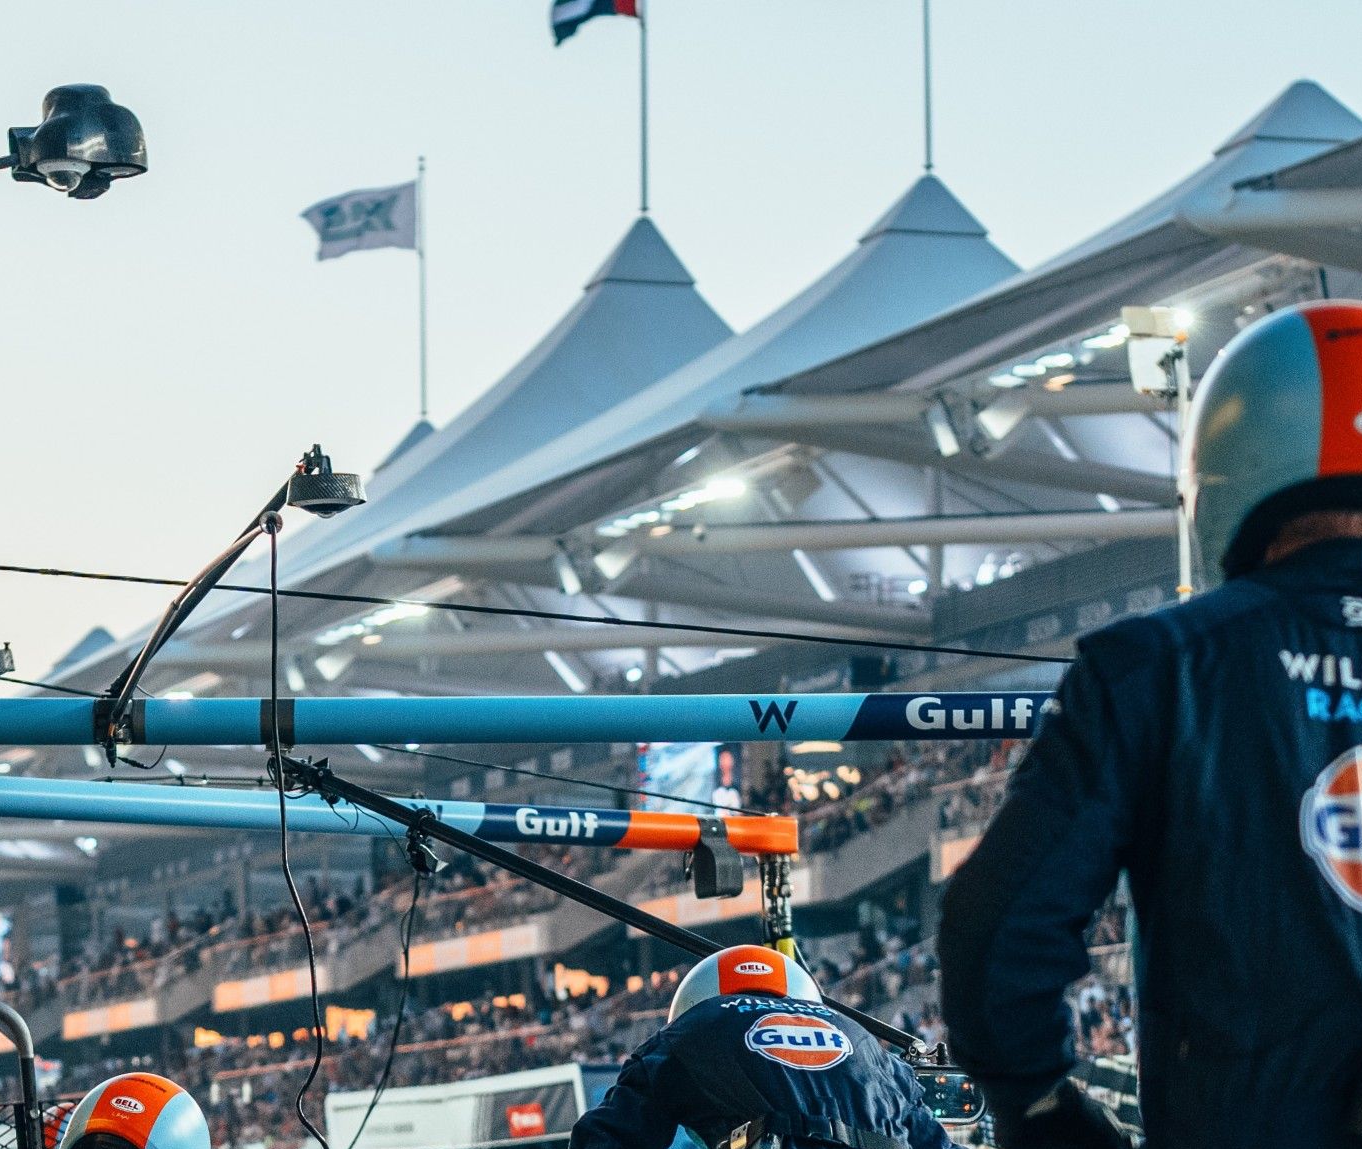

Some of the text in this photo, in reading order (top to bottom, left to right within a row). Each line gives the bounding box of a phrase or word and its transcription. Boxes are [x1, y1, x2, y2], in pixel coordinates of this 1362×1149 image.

[905, 696, 1034, 730] Gulf
[515, 807, 598, 838] Gulf
[739, 964, 768, 972] BELL
[751, 1028, 845, 1049] Gulf
[115, 1098, 139, 1110] BELL
